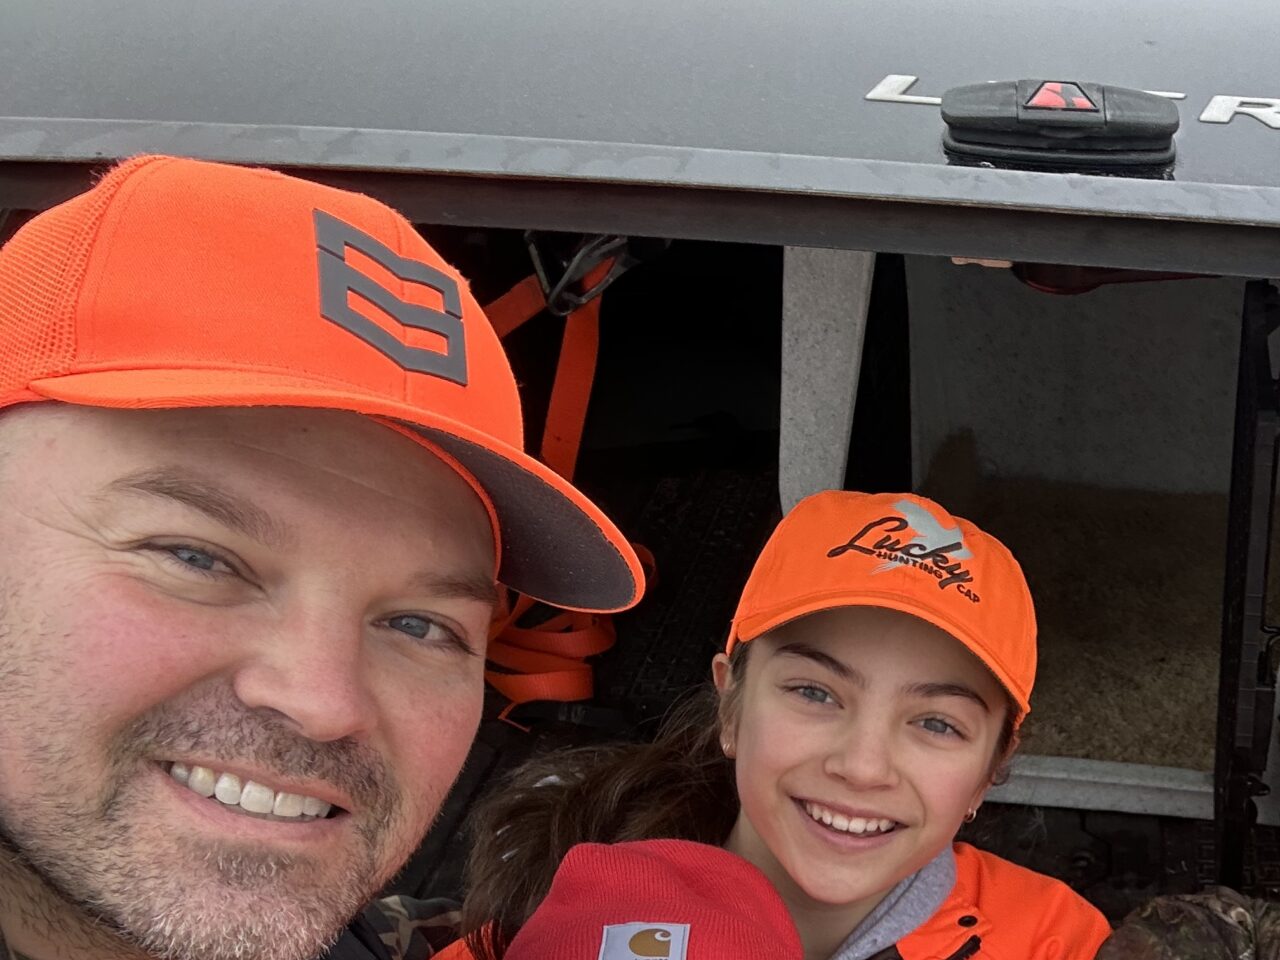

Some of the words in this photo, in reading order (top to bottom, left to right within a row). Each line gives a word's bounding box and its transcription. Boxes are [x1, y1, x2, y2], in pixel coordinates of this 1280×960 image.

[827, 516, 974, 590] Lucky
[875, 551, 944, 580] HUNTING
[956, 583, 981, 604] CAP
